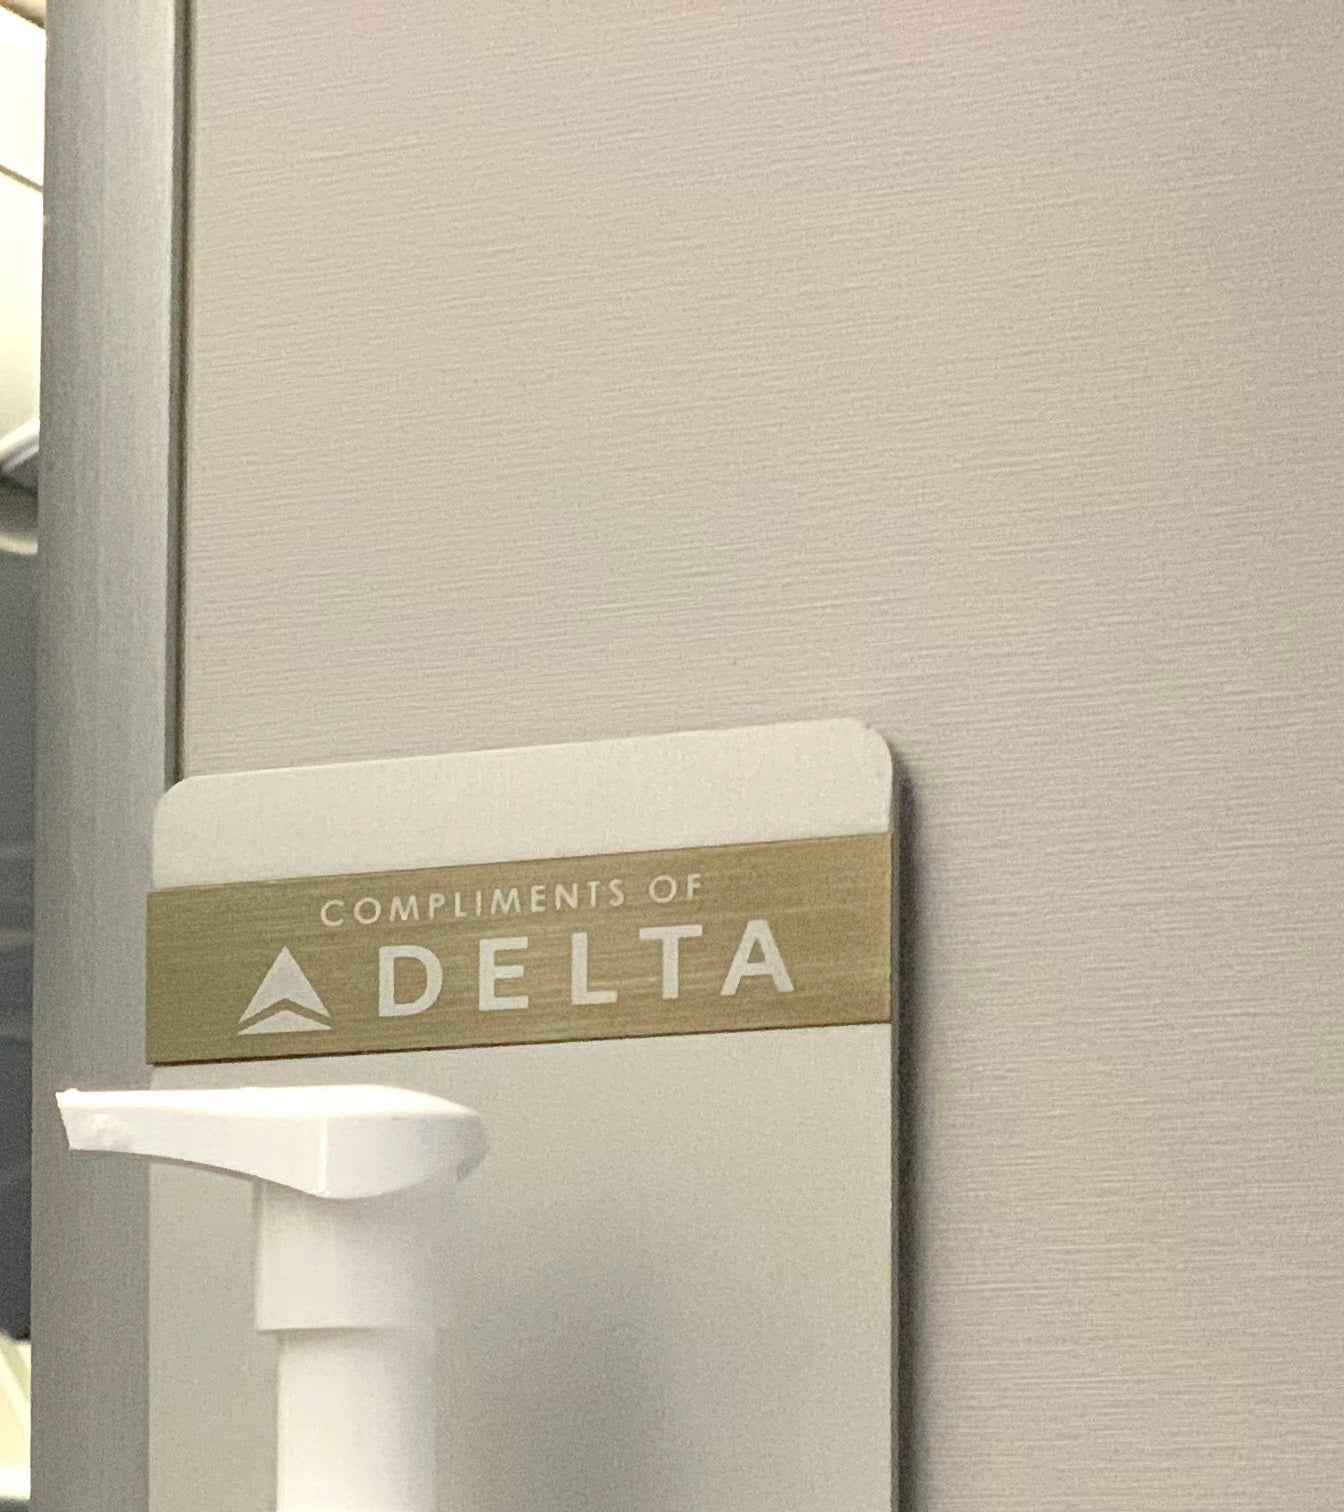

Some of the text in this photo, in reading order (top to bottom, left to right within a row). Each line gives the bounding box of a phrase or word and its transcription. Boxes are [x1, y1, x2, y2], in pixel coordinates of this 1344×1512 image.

[320, 873, 703, 928] COMPLIMENTS OF
[378, 918, 795, 1017] DELTA
